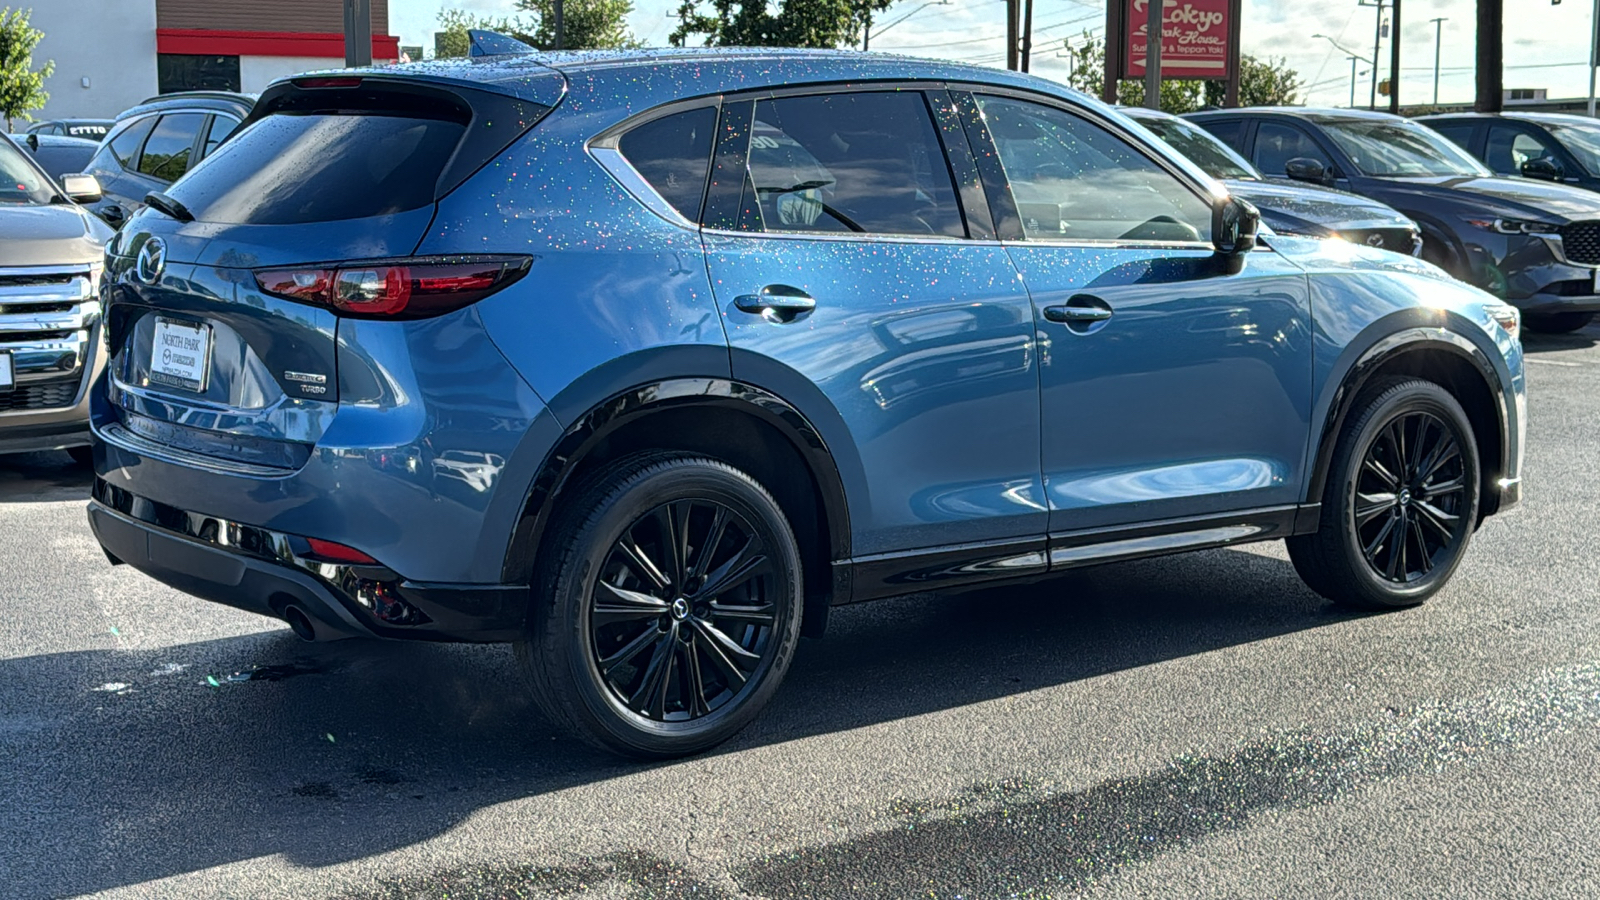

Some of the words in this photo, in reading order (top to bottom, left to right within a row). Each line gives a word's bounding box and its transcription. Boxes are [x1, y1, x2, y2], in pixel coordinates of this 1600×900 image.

[1133, 0, 1223, 32] Tokyo
[1132, 24, 1181, 37] Sak
[1178, 30, 1225, 44] House
[1177, 45, 1206, 54] Teppan
[162, 333, 183, 349] NORTH
[184, 337, 200, 351] PARK
[300, 385, 326, 393] TURBO
